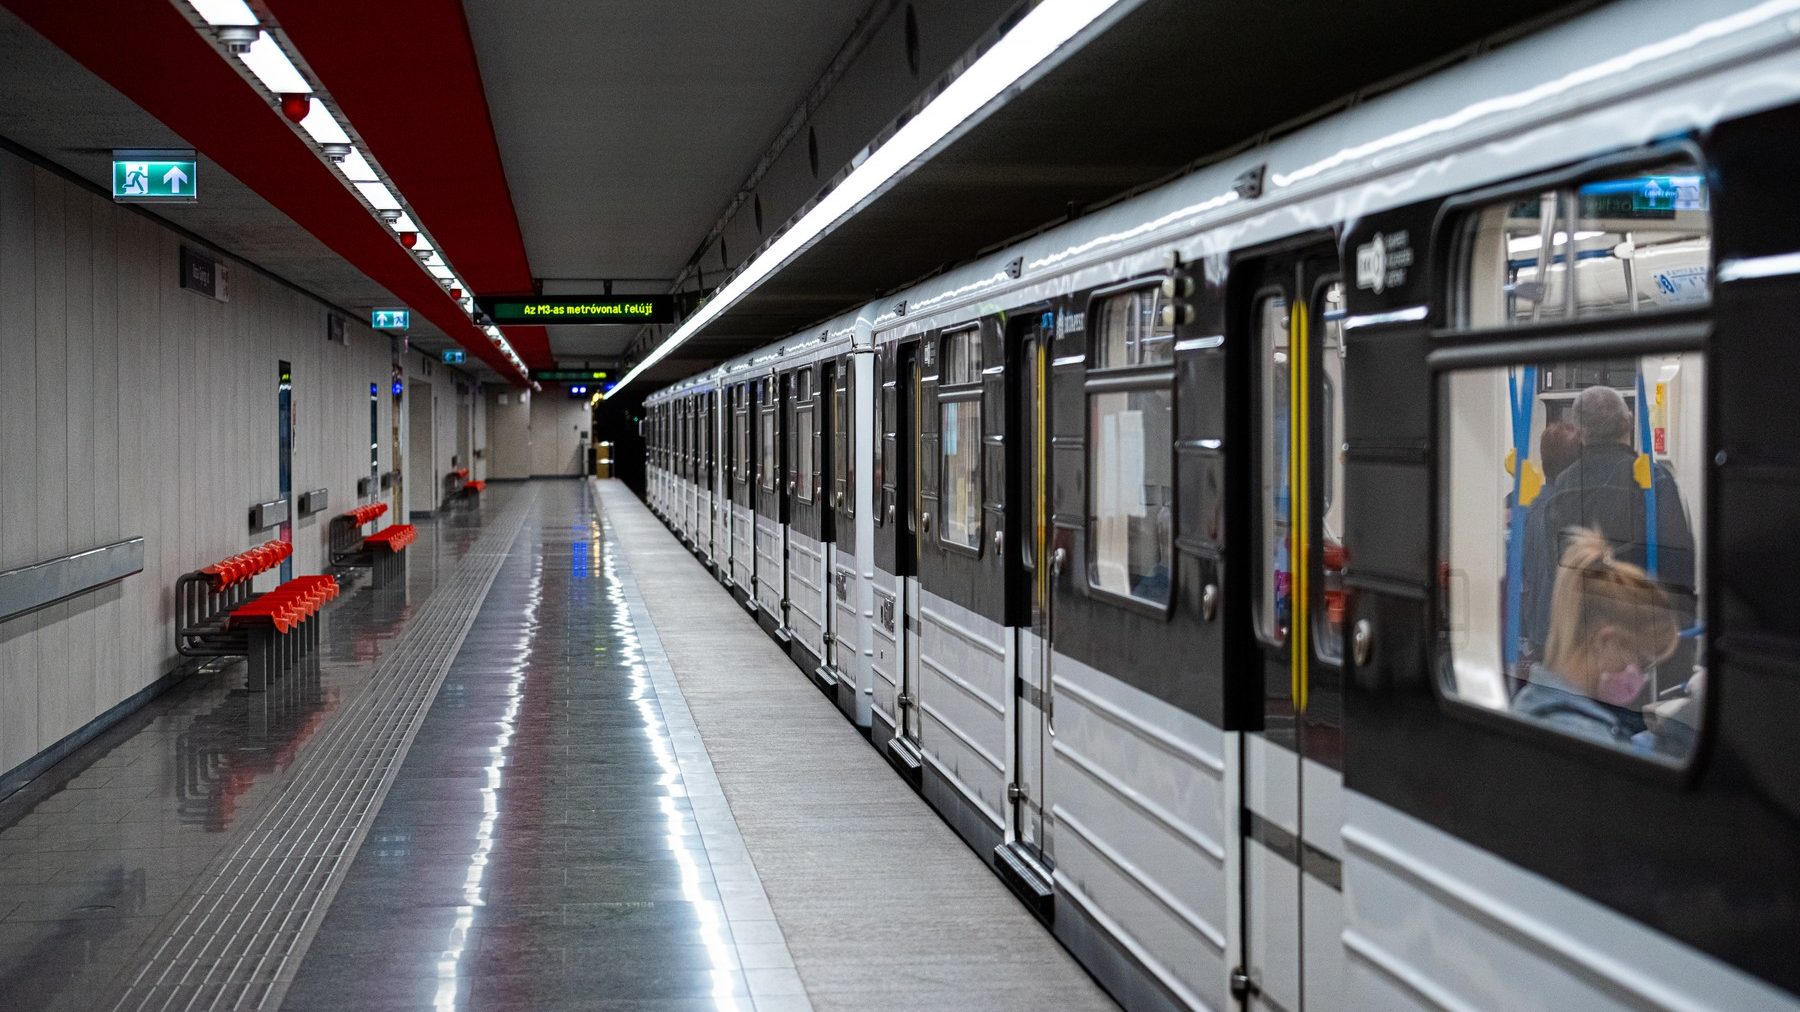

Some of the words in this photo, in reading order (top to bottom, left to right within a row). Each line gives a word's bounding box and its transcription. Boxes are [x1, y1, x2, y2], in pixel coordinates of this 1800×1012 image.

[524, 305, 536, 315] Az
[537, 305, 564, 315] M3-as
[566, 304, 622, 314] metróvonal
